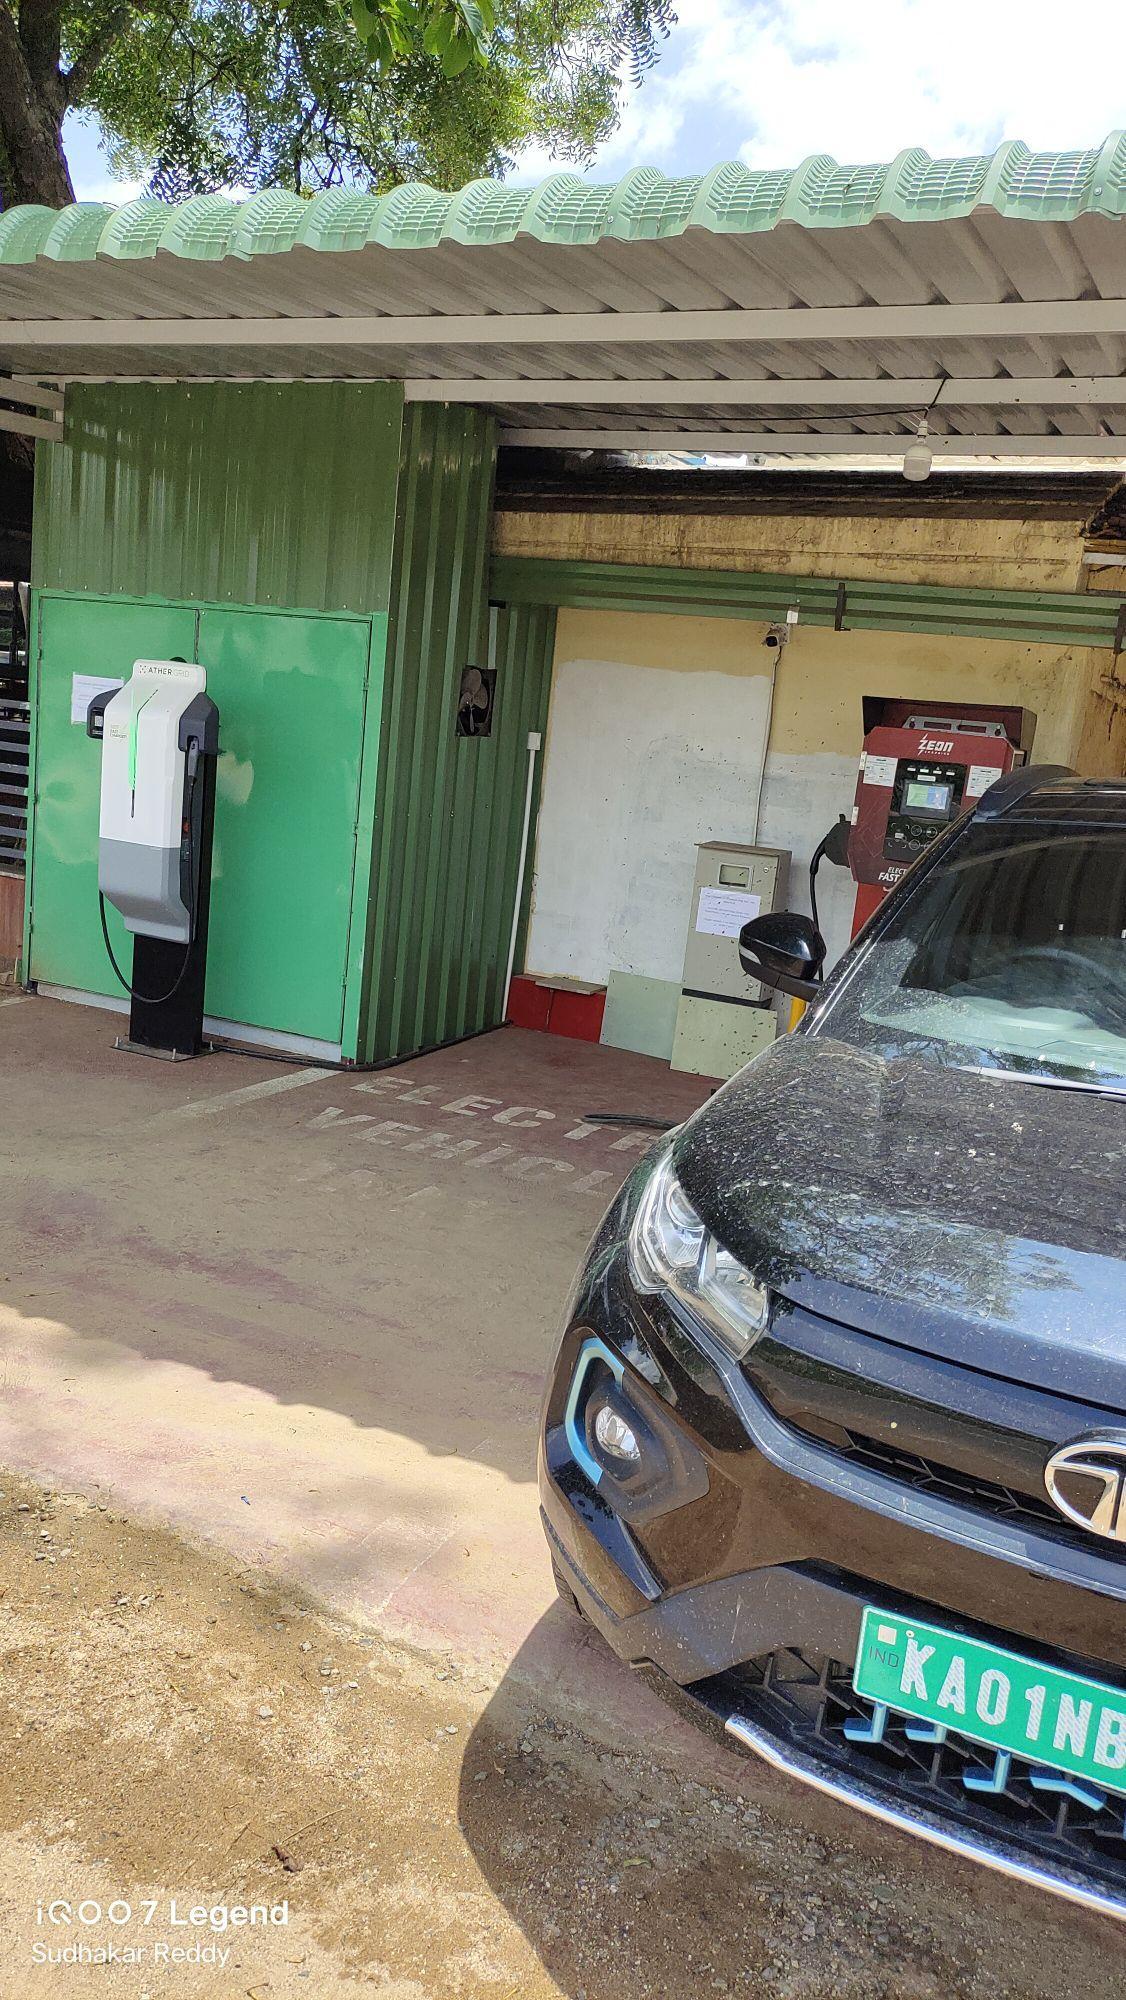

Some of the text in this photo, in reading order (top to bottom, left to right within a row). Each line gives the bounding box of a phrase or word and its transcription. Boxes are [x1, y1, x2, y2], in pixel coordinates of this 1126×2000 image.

[918, 737, 954, 753] ZEON
[878, 872, 900, 882] FAST
[870, 1646, 899, 1667] IND
